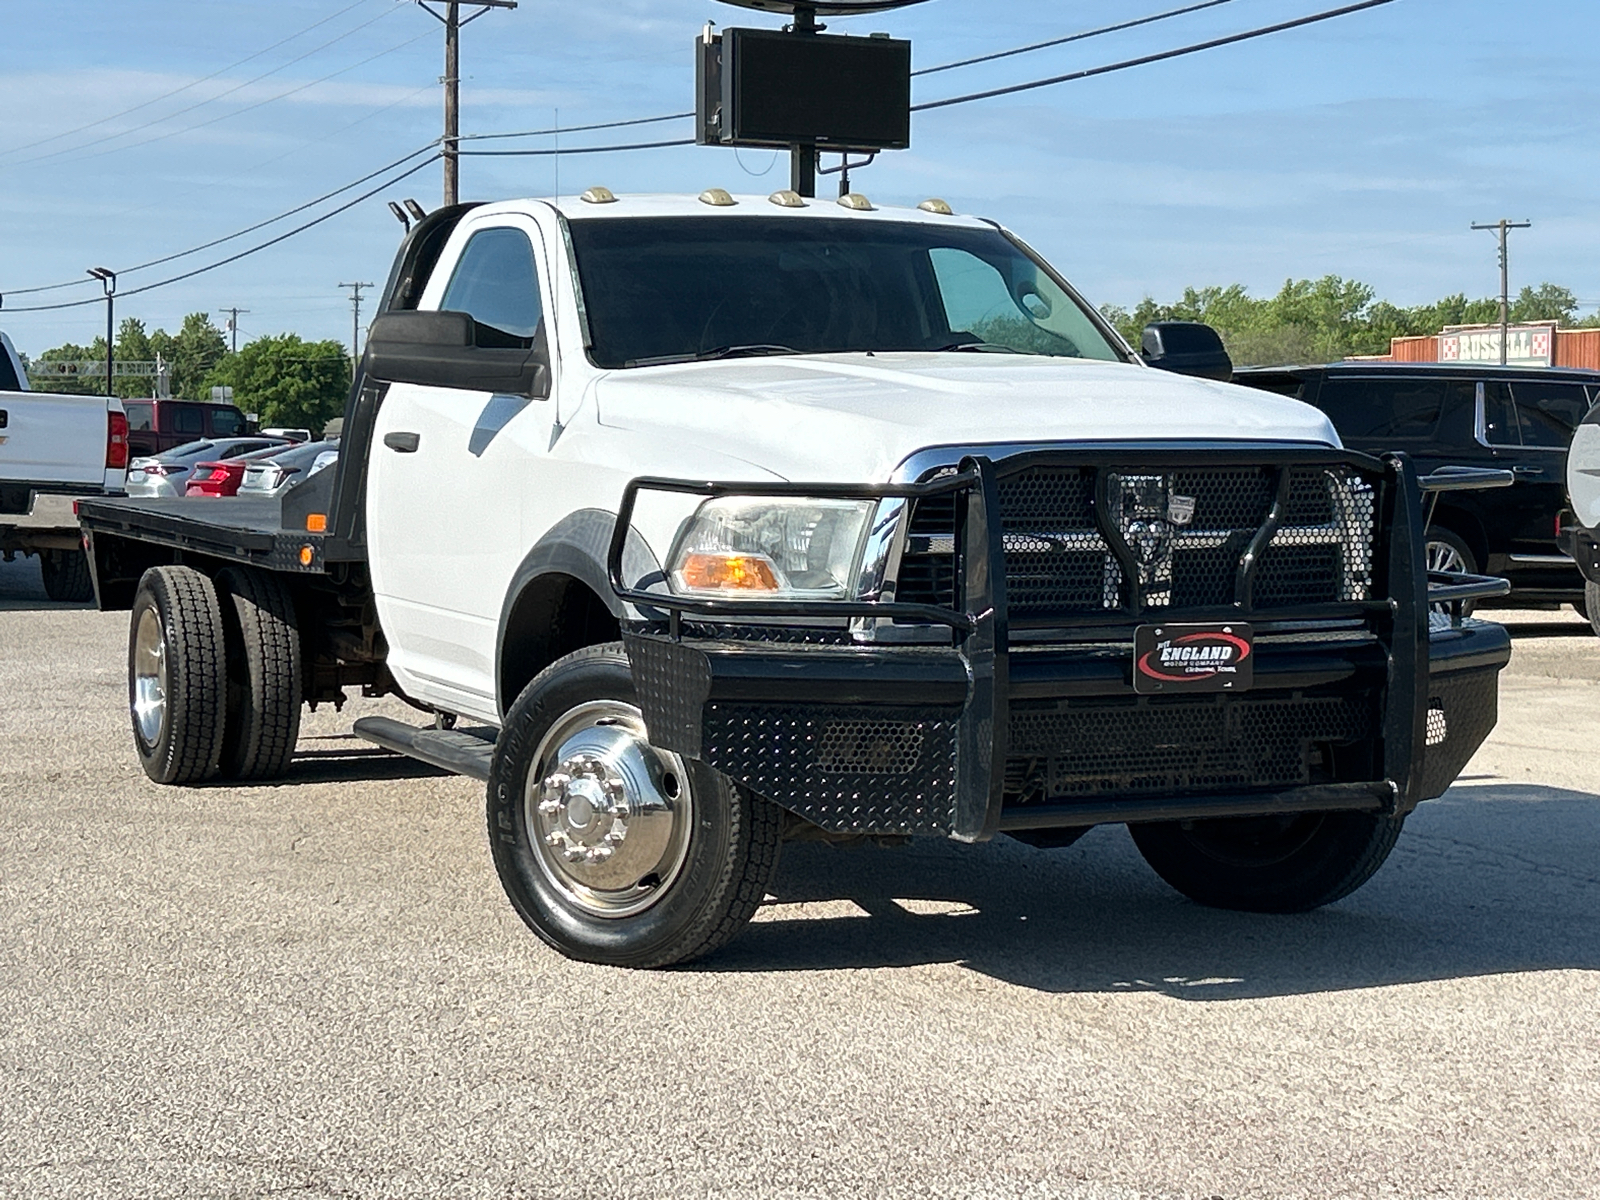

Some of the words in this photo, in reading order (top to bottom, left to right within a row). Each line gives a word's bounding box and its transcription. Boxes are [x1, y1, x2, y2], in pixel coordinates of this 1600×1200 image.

[1459, 332, 1530, 360] RUSSLL
[1160, 646, 1233, 661] ENGLAND
[497, 693, 546, 845] IRONMAN
